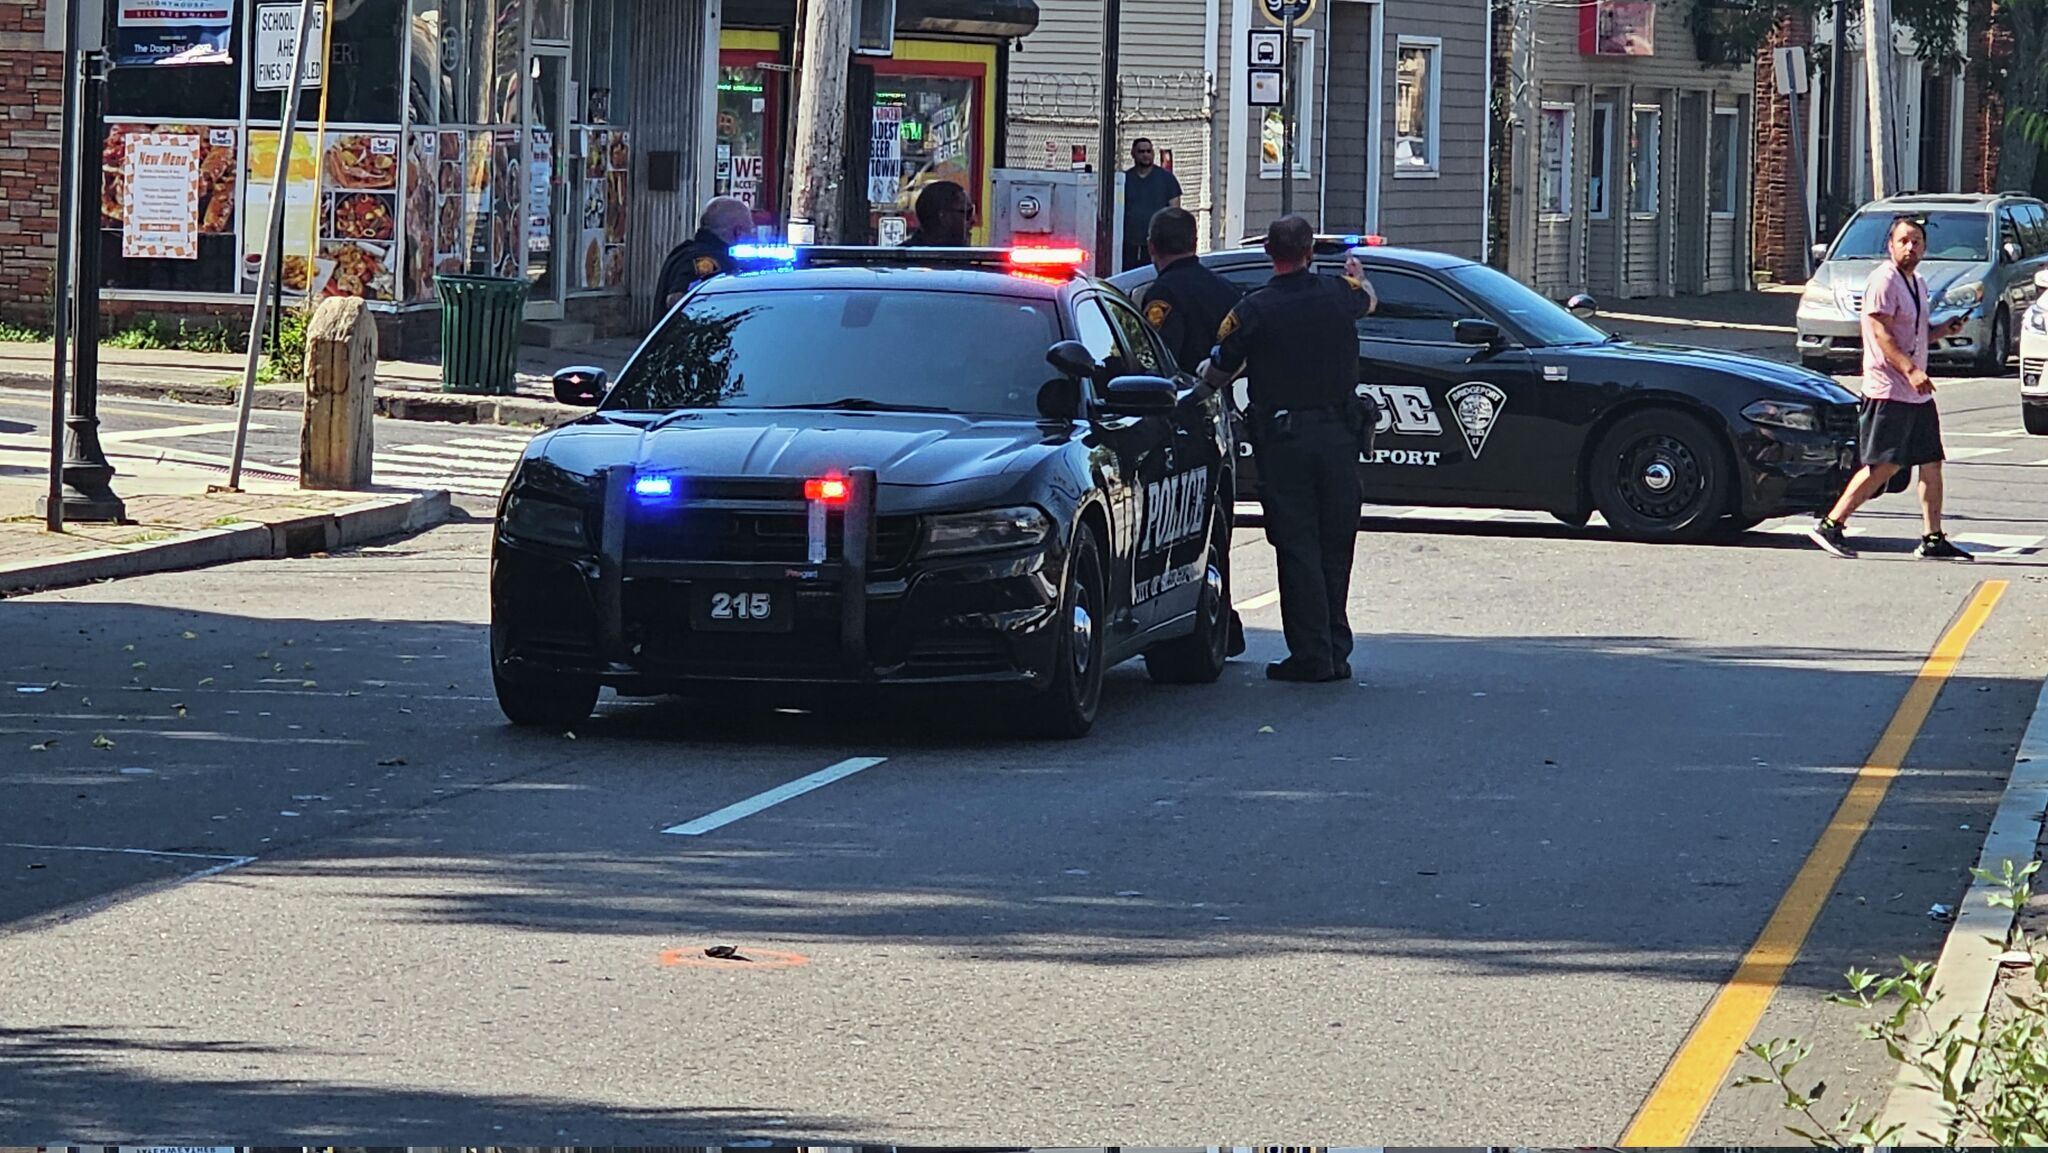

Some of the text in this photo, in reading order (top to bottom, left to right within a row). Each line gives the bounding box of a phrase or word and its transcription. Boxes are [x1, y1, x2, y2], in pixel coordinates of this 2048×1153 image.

[262, 12, 294, 31] SCHOOL
[134, 43, 148, 53] The
[149, 43, 171, 54] Dope
[277, 38, 294, 57] AHE
[259, 63, 281, 81] FINES
[139, 151, 188, 167] New Menu
[734, 158, 762, 178] WE
[870, 159, 899, 178] TOWN!
[1451, 385, 1502, 402] BRIDGEPORT
[1142, 465, 1208, 553] POLICE
[711, 592, 771, 620] 215
